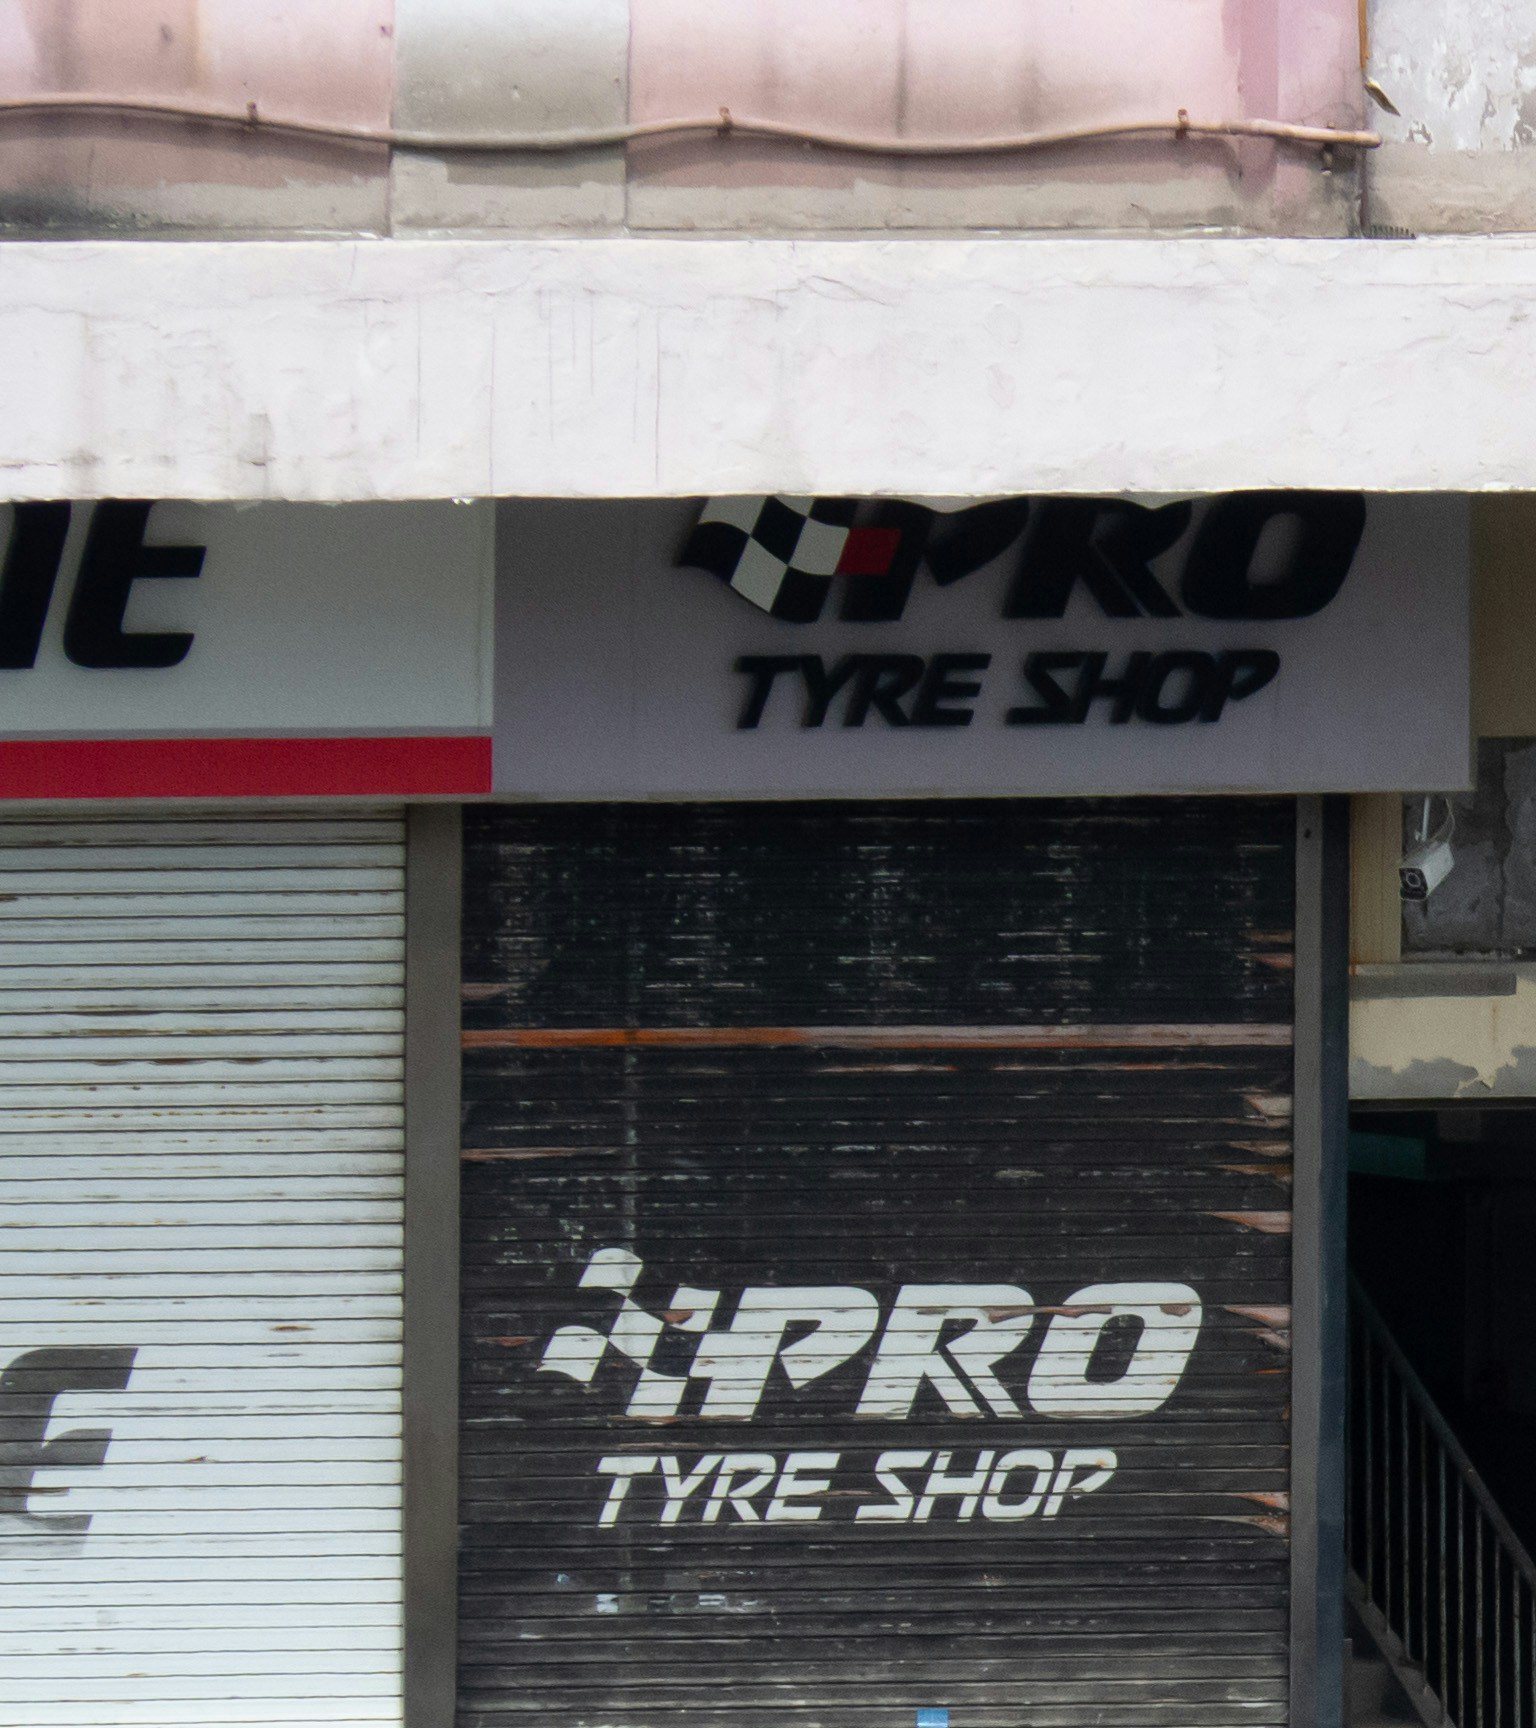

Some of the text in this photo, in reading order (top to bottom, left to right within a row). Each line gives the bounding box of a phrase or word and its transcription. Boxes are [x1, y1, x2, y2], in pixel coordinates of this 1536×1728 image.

[838, 491, 1367, 622] PRO
[733, 647, 1281, 729] TYRE SHOP
[697, 1282, 1202, 1419] PRO
[597, 1449, 1118, 1528] TYRE SHOP
